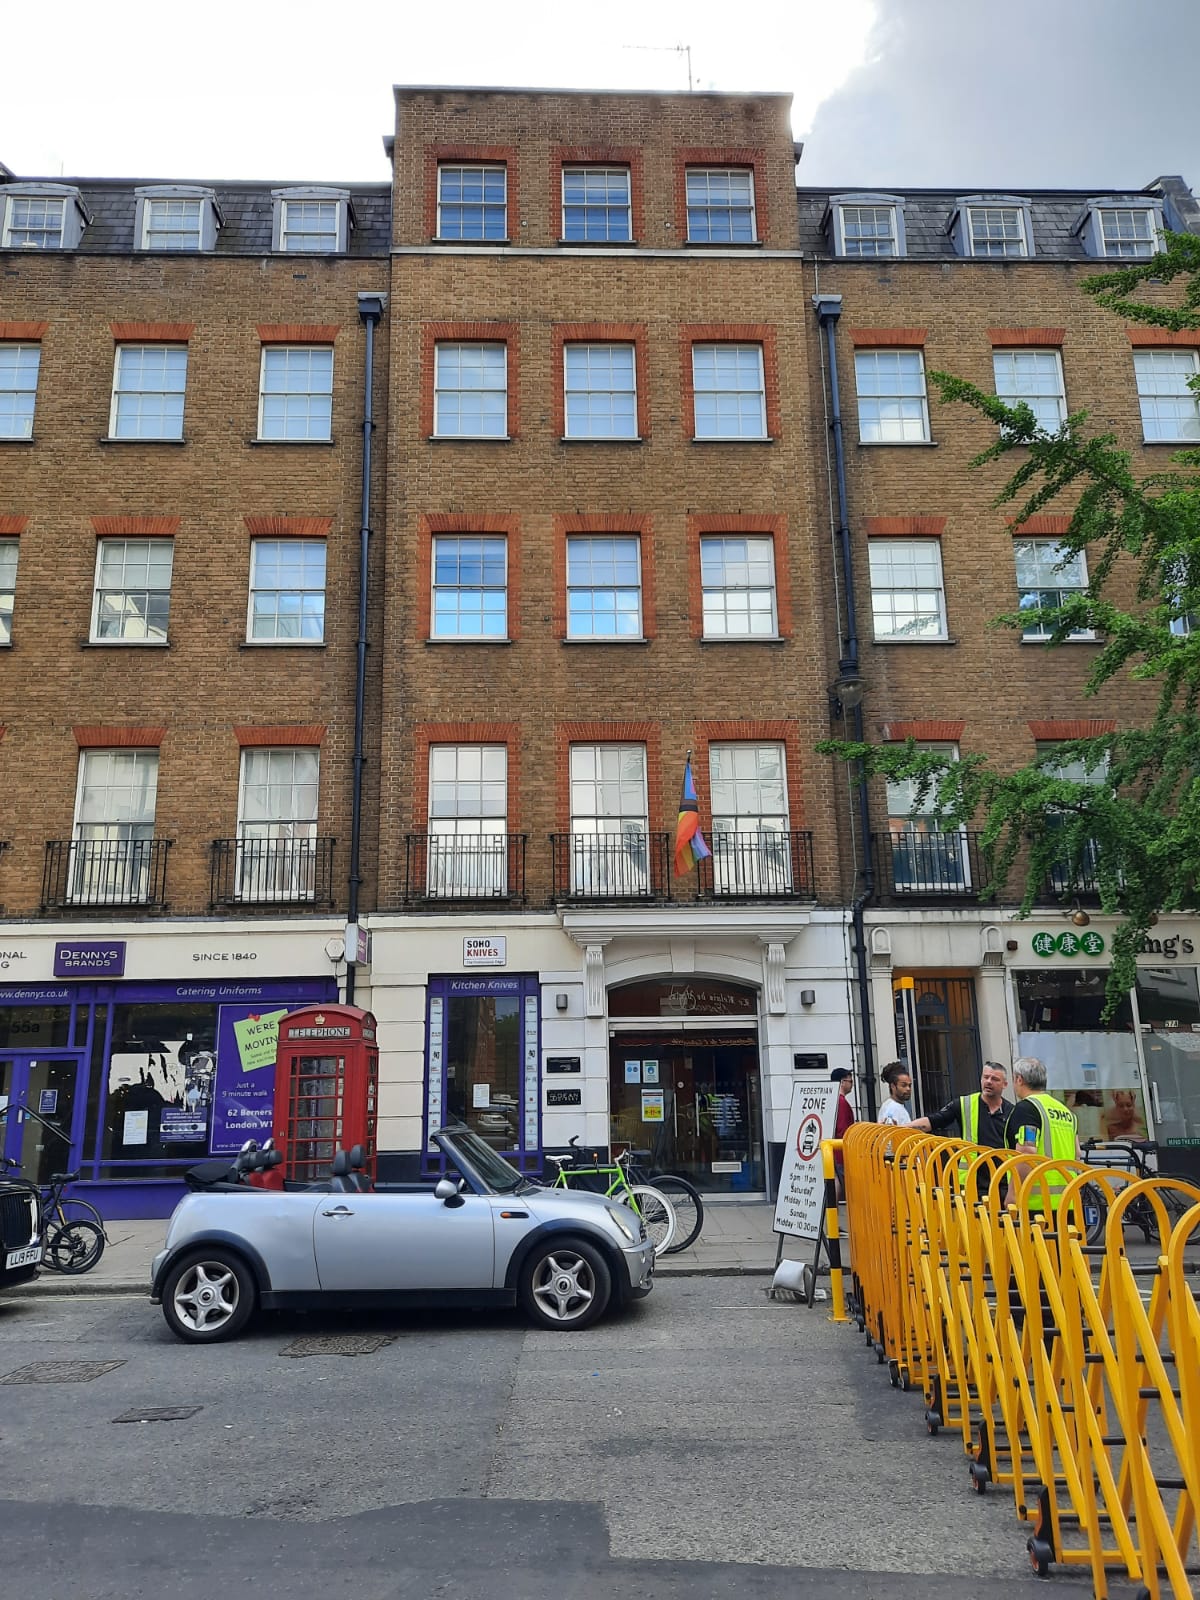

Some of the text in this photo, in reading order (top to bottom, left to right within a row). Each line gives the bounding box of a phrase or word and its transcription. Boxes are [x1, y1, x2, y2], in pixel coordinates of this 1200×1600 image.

[466, 940, 490, 949] SOHO
[1034, 934, 1100, 953] 健康堂
[60, 950, 118, 960] DENNYS
[192, 952, 257, 962] SINCE 1840
[466, 949, 498, 957] KNIVES
[451, 981, 518, 990] Kitchen Knives
[176, 986, 262, 997] Catering Uniforms
[289, 1027, 349, 1037] TELEPHONE
[244, 1035, 278, 1051] MOVIN
[800, 1087, 833, 1095] PEDESTRIAN
[802, 1098, 826, 1110] ZONE
[227, 1109, 238, 1117] 62
[225, 1121, 257, 1129] London
[790, 1184, 814, 1196] Saturday
[784, 1195, 801, 1207] Midday
[789, 1209, 807, 1220] Sunday
[776, 1217, 793, 1229] Midday
